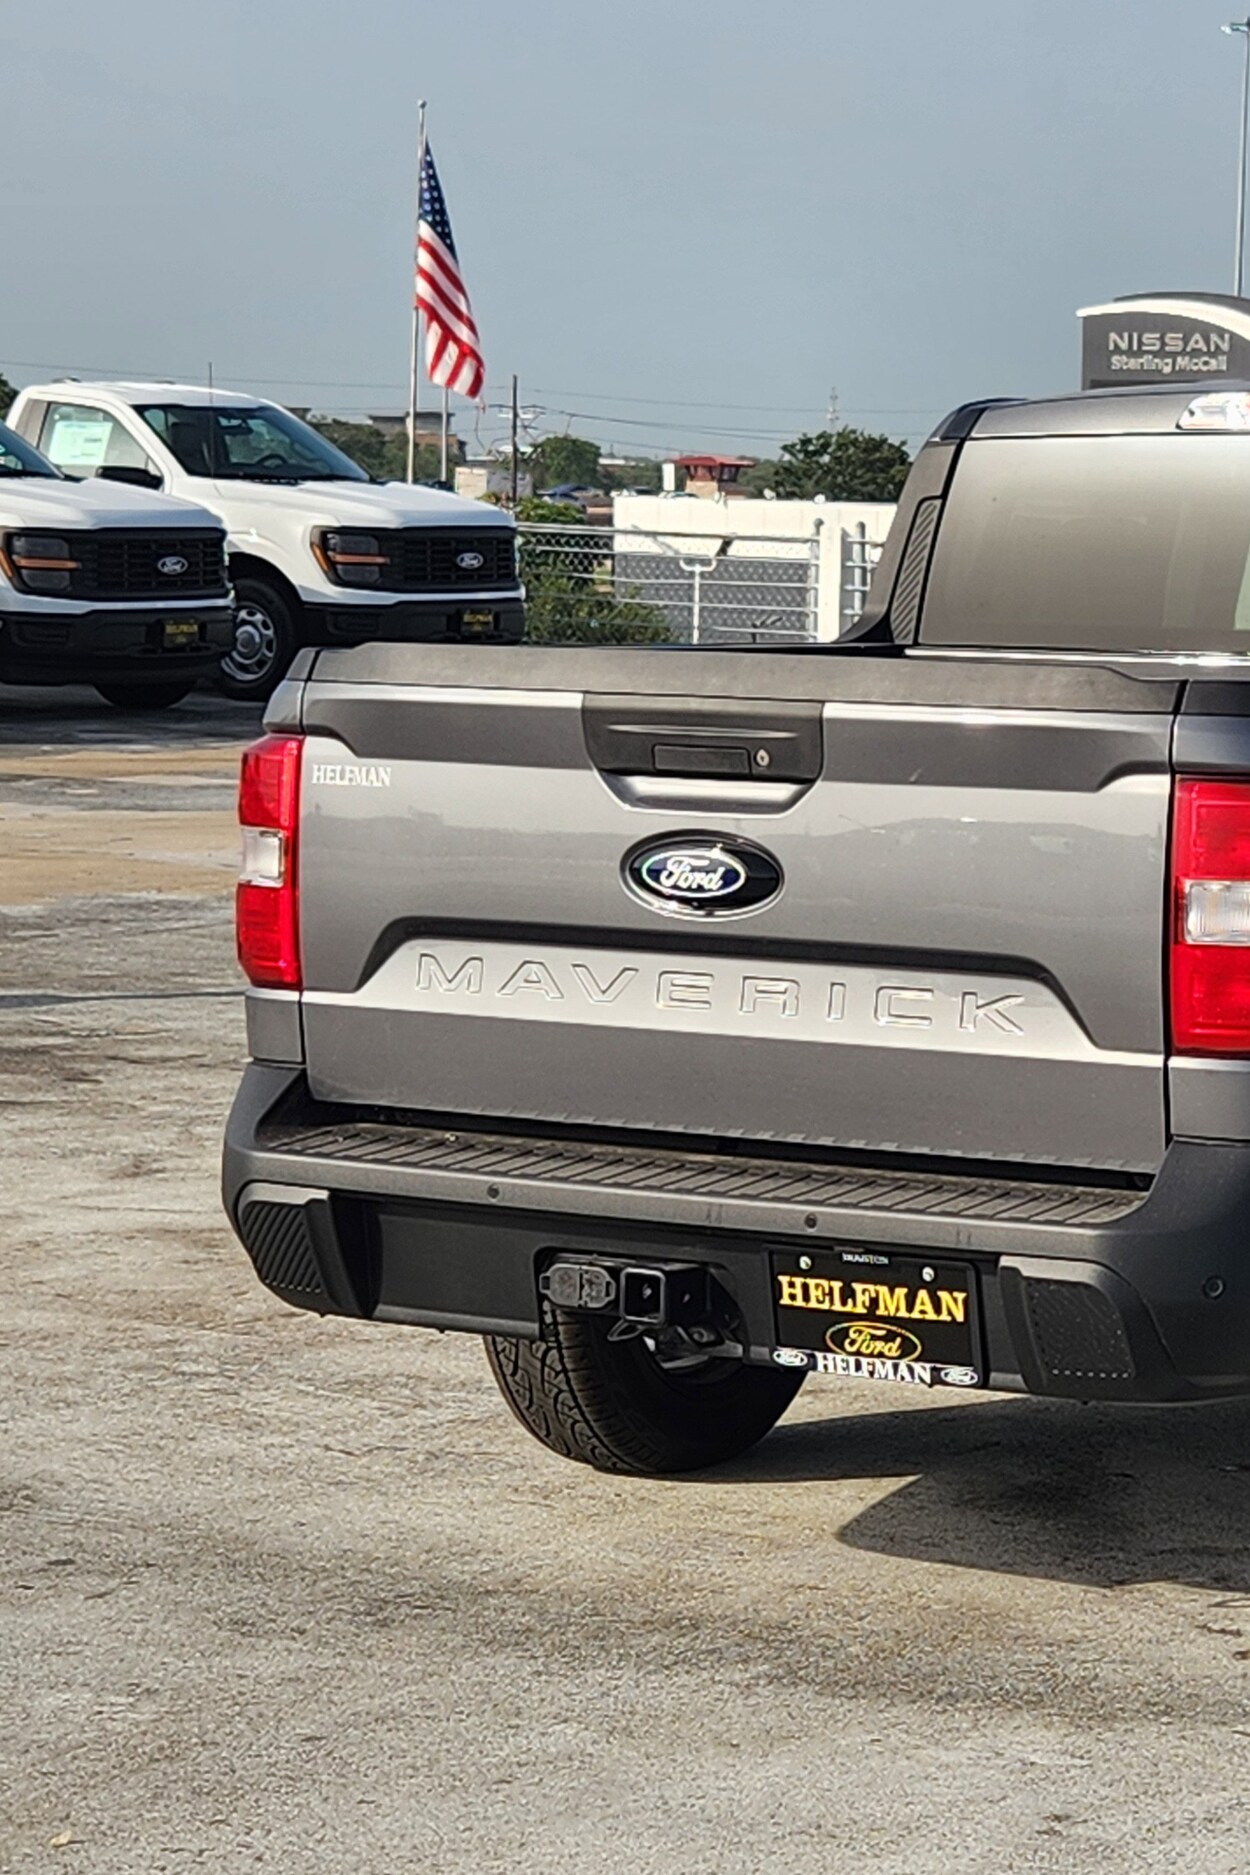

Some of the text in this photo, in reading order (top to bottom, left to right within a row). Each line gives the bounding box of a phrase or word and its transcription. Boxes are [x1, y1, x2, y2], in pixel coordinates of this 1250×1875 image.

[1108, 331, 1231, 352] NISSAN
[1110, 355, 1228, 374] Sterling McCall
[311, 764, 391, 787] HELFMAN
[659, 856, 726, 891] Ford
[415, 953, 1026, 1036] MAVERICK
[777, 1275, 967, 1322] HELFMAN
[844, 1326, 902, 1356] Ford
[815, 1354, 932, 1383] HELFMAN
